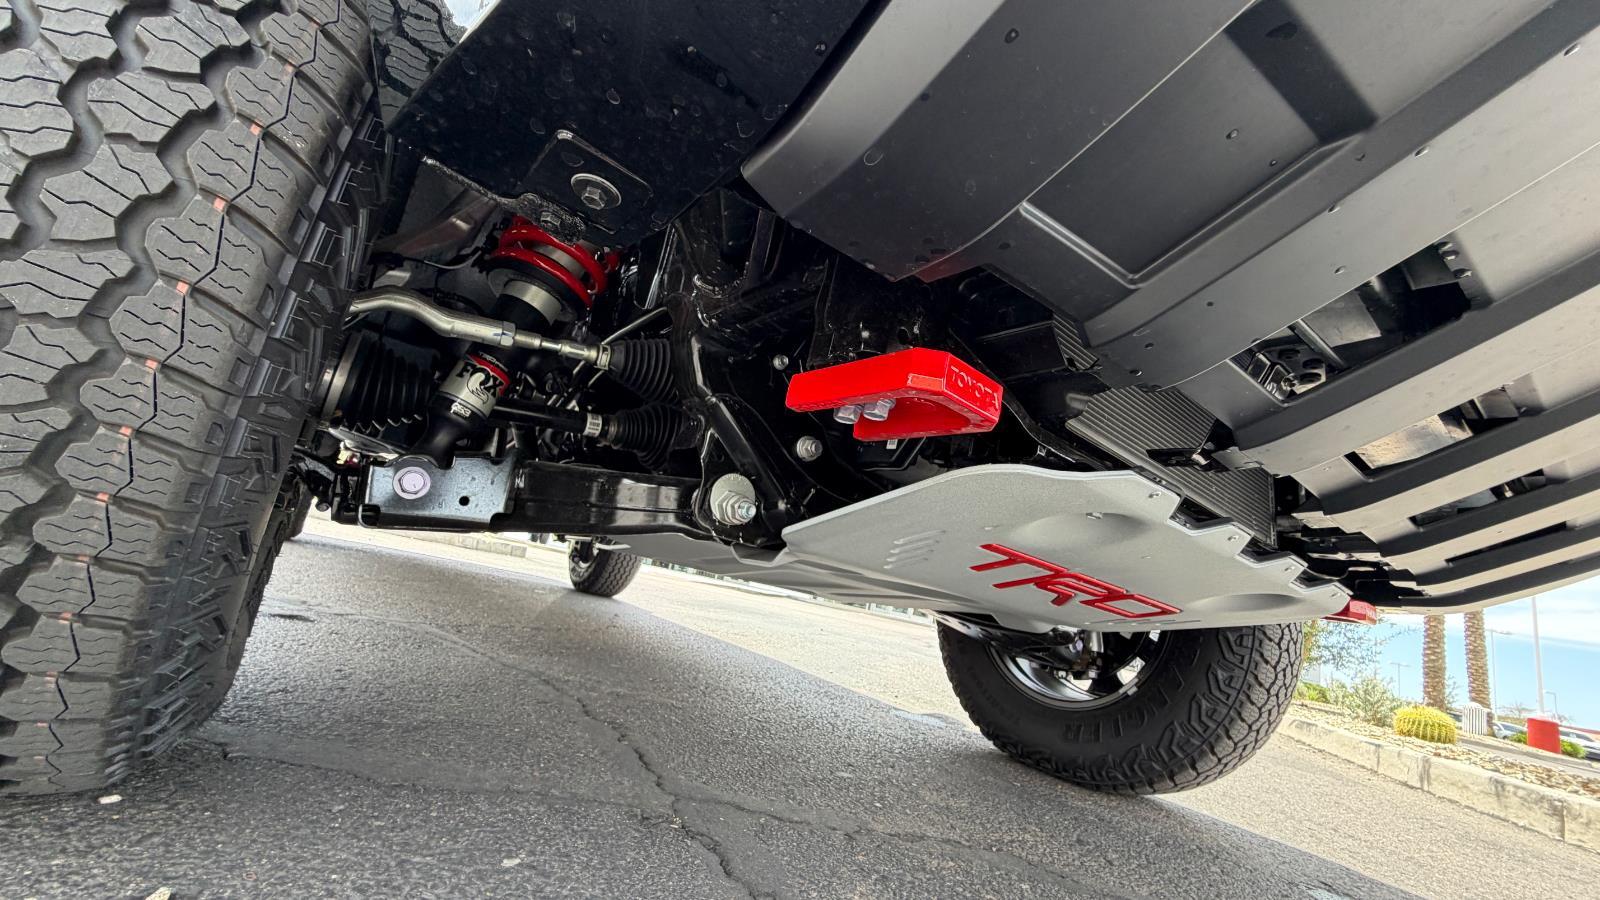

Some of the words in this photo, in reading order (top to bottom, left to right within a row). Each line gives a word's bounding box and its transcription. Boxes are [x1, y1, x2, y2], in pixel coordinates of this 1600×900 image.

[456, 360, 504, 399] FOX
[950, 365, 999, 410] TOYOTA
[968, 543, 1183, 619] TRD
